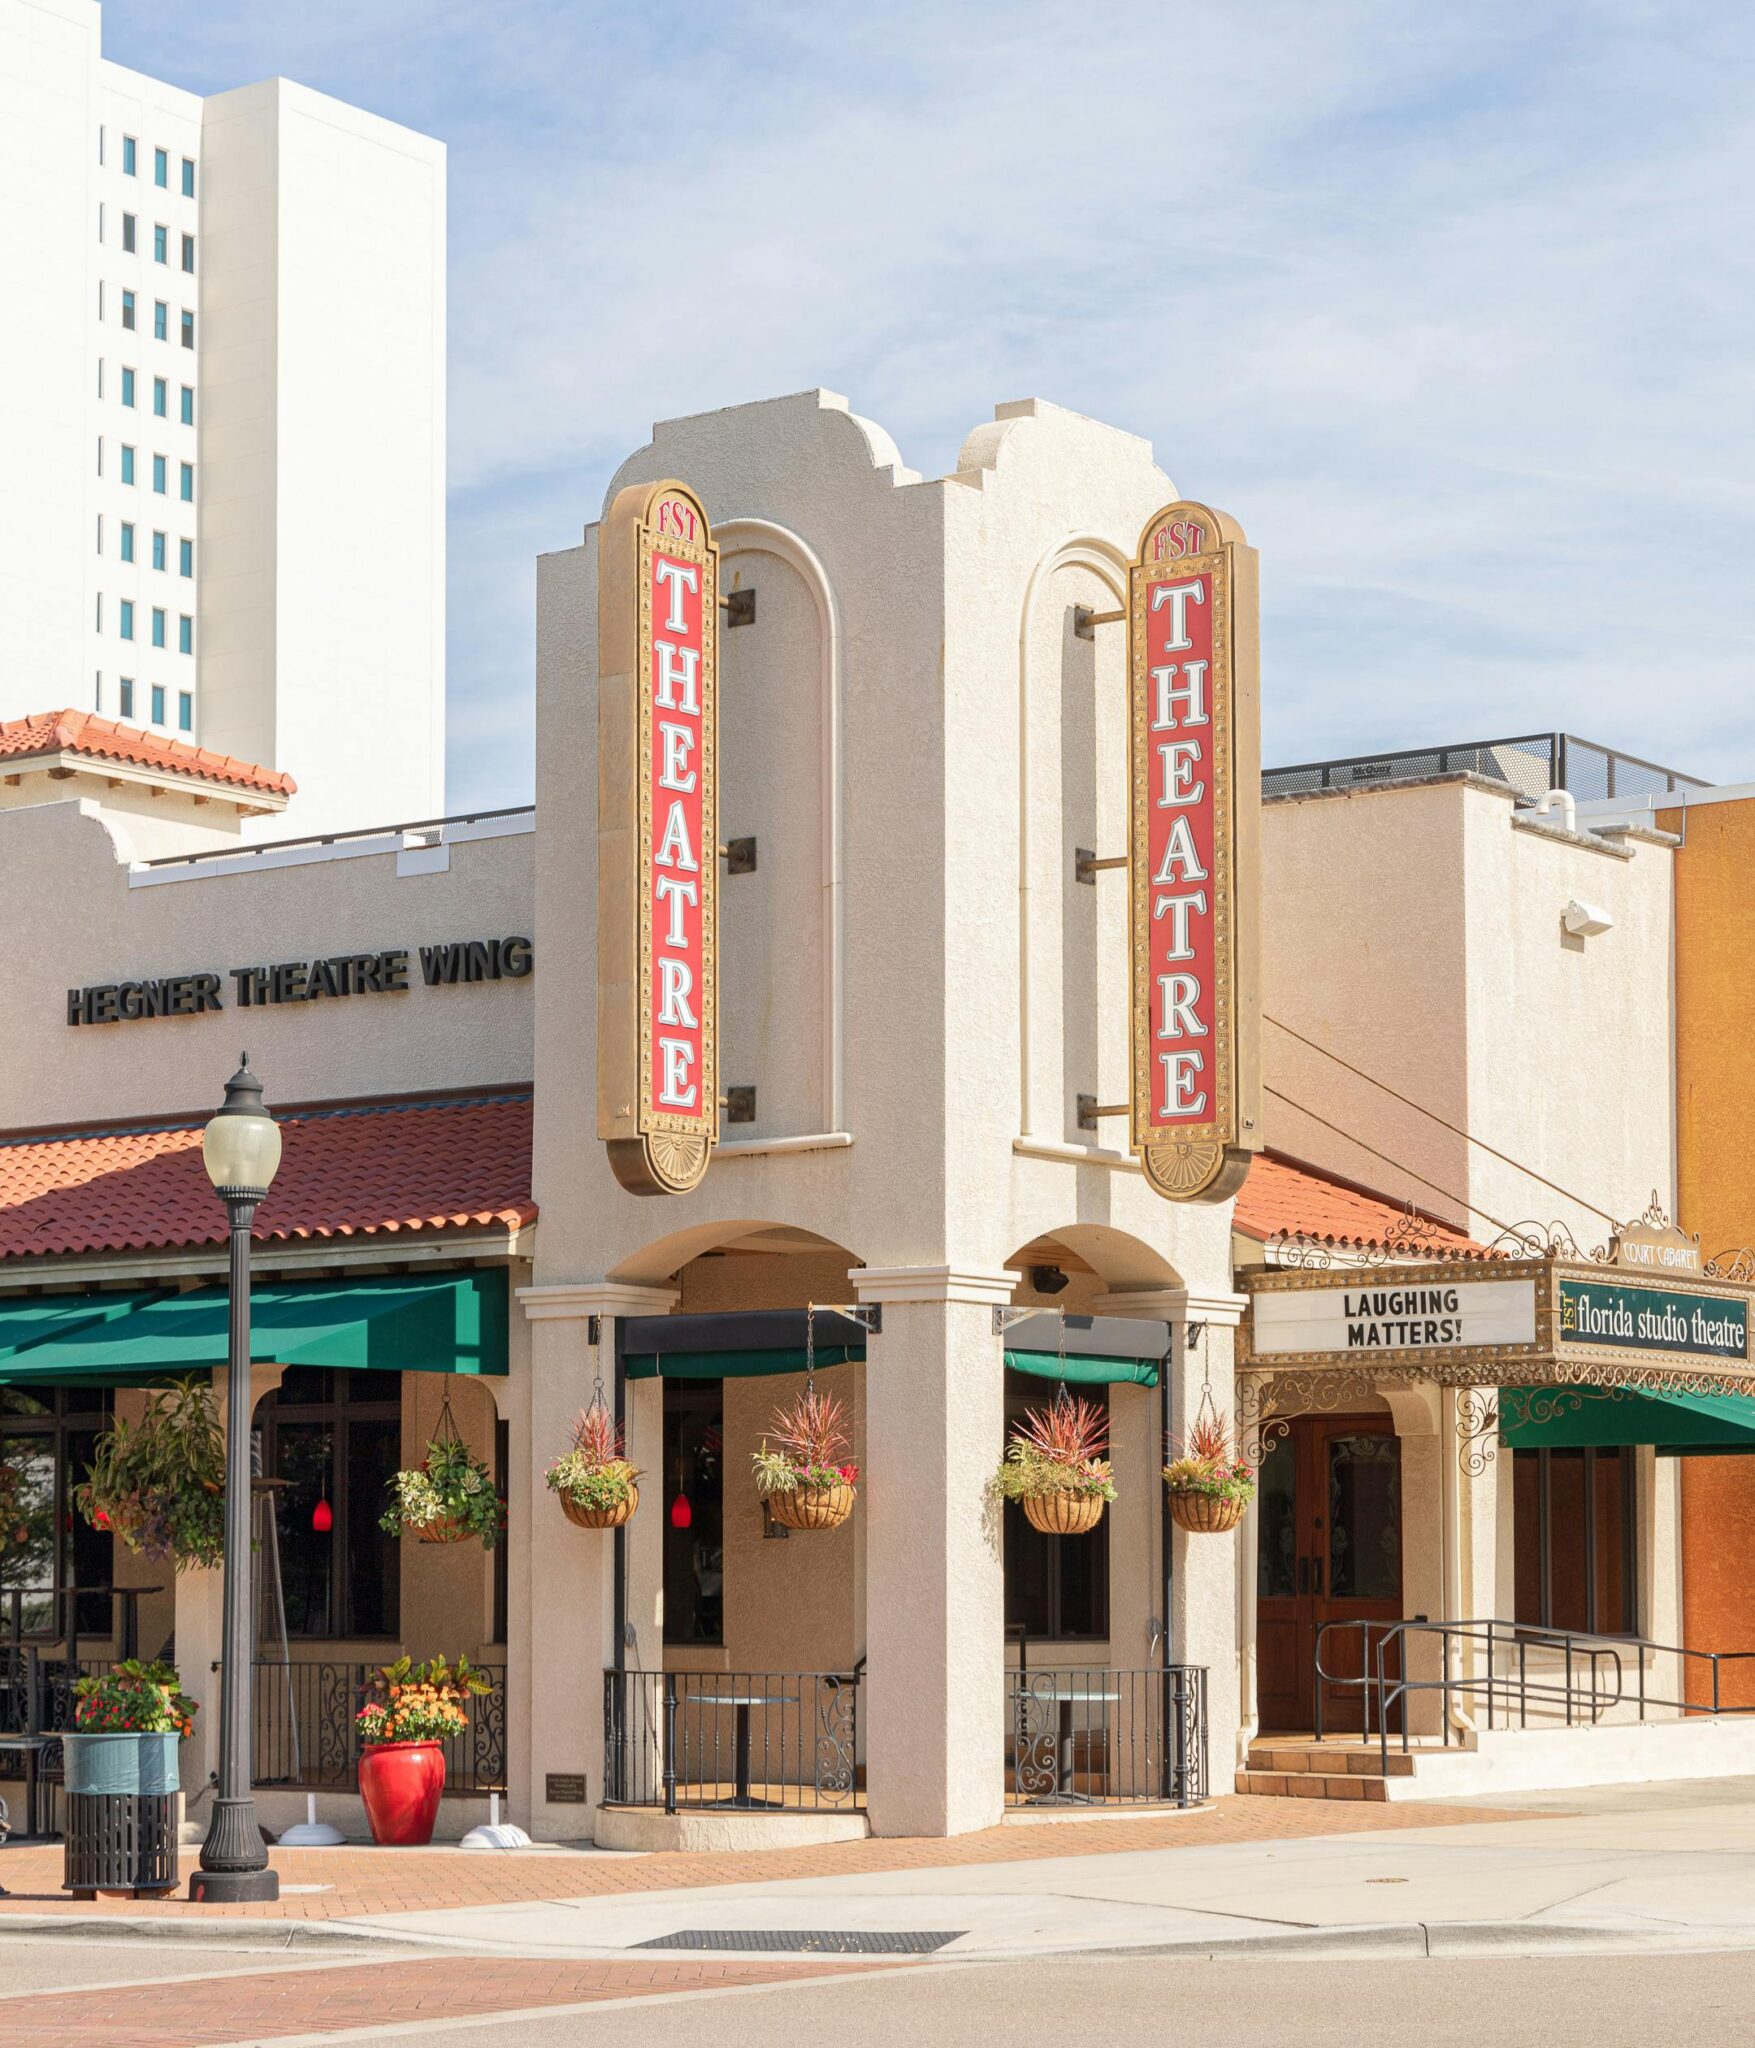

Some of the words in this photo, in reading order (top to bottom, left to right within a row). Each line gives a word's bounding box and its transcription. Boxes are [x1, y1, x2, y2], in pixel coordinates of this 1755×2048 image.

[657, 500, 699, 543] FST
[1152, 520, 1205, 561] FST
[655, 558, 700, 1108] THEATRE
[1151, 579, 1210, 1118] THEATRE
[67, 973, 223, 1026] HEGNER
[229, 950, 409, 1007] THEATRE
[418, 936, 532, 985] WING
[1623, 1242, 1655, 1265] COURT
[1657, 1246, 1698, 1271] CABARET
[1344, 1289, 1459, 1317] LAUGHING
[1562, 1294, 1575, 1331] FST
[1577, 1294, 1634, 1338] florida
[1638, 1304, 1688, 1343] studio
[1691, 1308, 1744, 1349] theatre
[1348, 1319, 1462, 1346] MATTERS!
